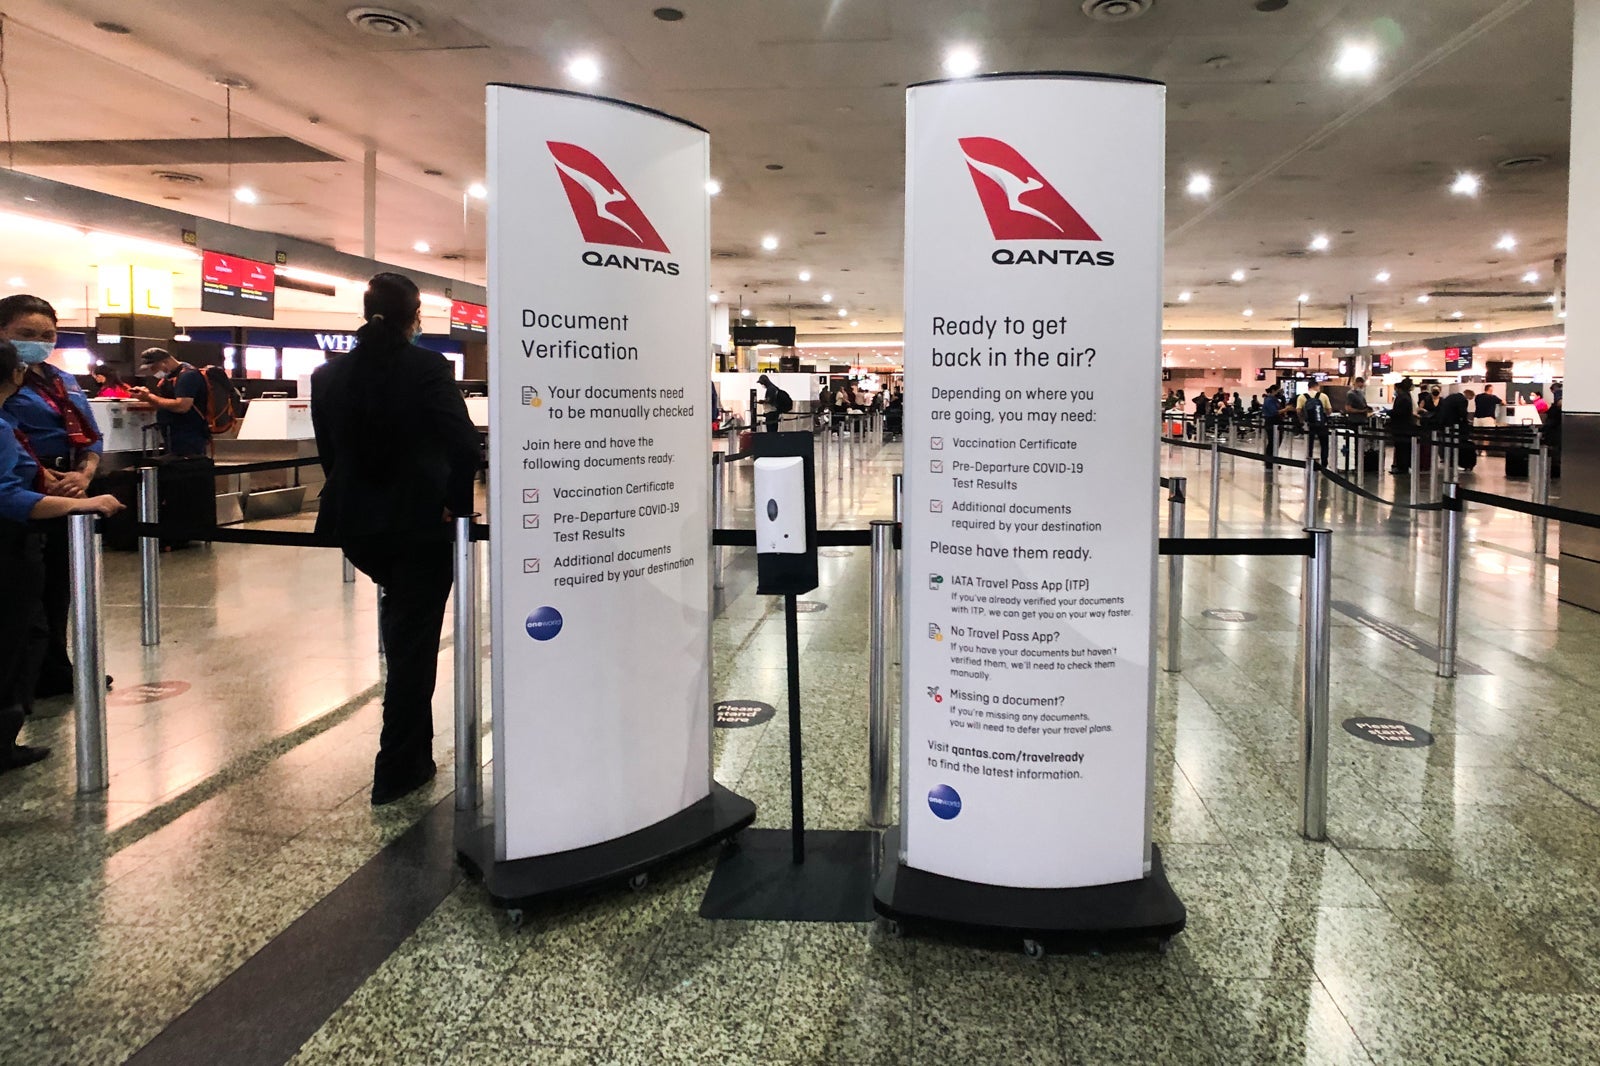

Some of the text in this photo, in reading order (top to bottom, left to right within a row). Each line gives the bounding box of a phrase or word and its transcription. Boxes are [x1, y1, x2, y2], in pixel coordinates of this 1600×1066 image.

[581, 251, 680, 276] QANTAS
[991, 249, 1115, 266] QANTAS
[147, 288, 160, 309] L
[522, 309, 629, 331] Document
[932, 315, 1067, 340] Ready to get
[521, 340, 638, 360] Verification
[932, 347, 1096, 368] back in the air?
[548, 386, 684, 399] Your documents need
[931, 387, 1094, 403] Depending on where you
[549, 405, 694, 420] to be manually checked
[931, 408, 1096, 424] are going, you may need:
[523, 437, 653, 450] Join here and have the
[952, 438, 1077, 450] Vaccination Certificate
[523, 458, 580, 470] following
[584, 454, 645, 468] documents
[952, 461, 1084, 474] Pre-Departure COVID-19
[553, 481, 675, 498] Vaccination Certificate
[952, 478, 1018, 490] Test Results
[554, 502, 680, 524] Pre-Departure COVID-19
[952, 501, 1072, 514] Additional documents
[951, 519, 1102, 532] required by your destination
[553, 527, 625, 542] Test Results
[554, 545, 672, 568] Additional documents
[930, 541, 1092, 561] Please have them ready.
[554, 557, 694, 587] required by your destination
[951, 575, 974, 586] IATA
[976, 577, 1008, 589] Travel
[1012, 579, 1038, 590] Pass
[1041, 580, 1062, 592] App
[989, 595, 1021, 606] already
[1024, 596, 1056, 606] verified
[1058, 598, 1077, 607] your
[1079, 596, 1125, 605] documents
[1003, 610, 1020, 618] can
[1022, 610, 1036, 619] get
[1038, 611, 1054, 620] you
[1069, 610, 1088, 620] your
[1089, 610, 1105, 618] way
[951, 625, 1060, 643] No Travel Pass App?
[959, 644, 974, 653] you
[976, 646, 997, 655] have
[999, 648, 1018, 657] your
[1020, 648, 1069, 657] documents
[1071, 648, 1085, 656] but
[950, 656, 982, 666] verified
[1033, 661, 1055, 670] need
[1057, 662, 1065, 670] to
[1067, 661, 1092, 669] check
[1095, 660, 1115, 668] them
[950, 688, 1065, 706] Missing a document?
[986, 710, 1020, 721] missing
[1022, 713, 1038, 722] any
[950, 719, 965, 728] you
[967, 720, 981, 729] will
[983, 723, 1004, 732] need
[1006, 725, 1015, 733] to
[1017, 725, 1040, 734] defer
[1042, 726, 1061, 735] your
[1063, 726, 1088, 734] travel
[928, 740, 1084, 763] Visit qantas.com/travelready
[928, 758, 1083, 780] to find the latest information.
